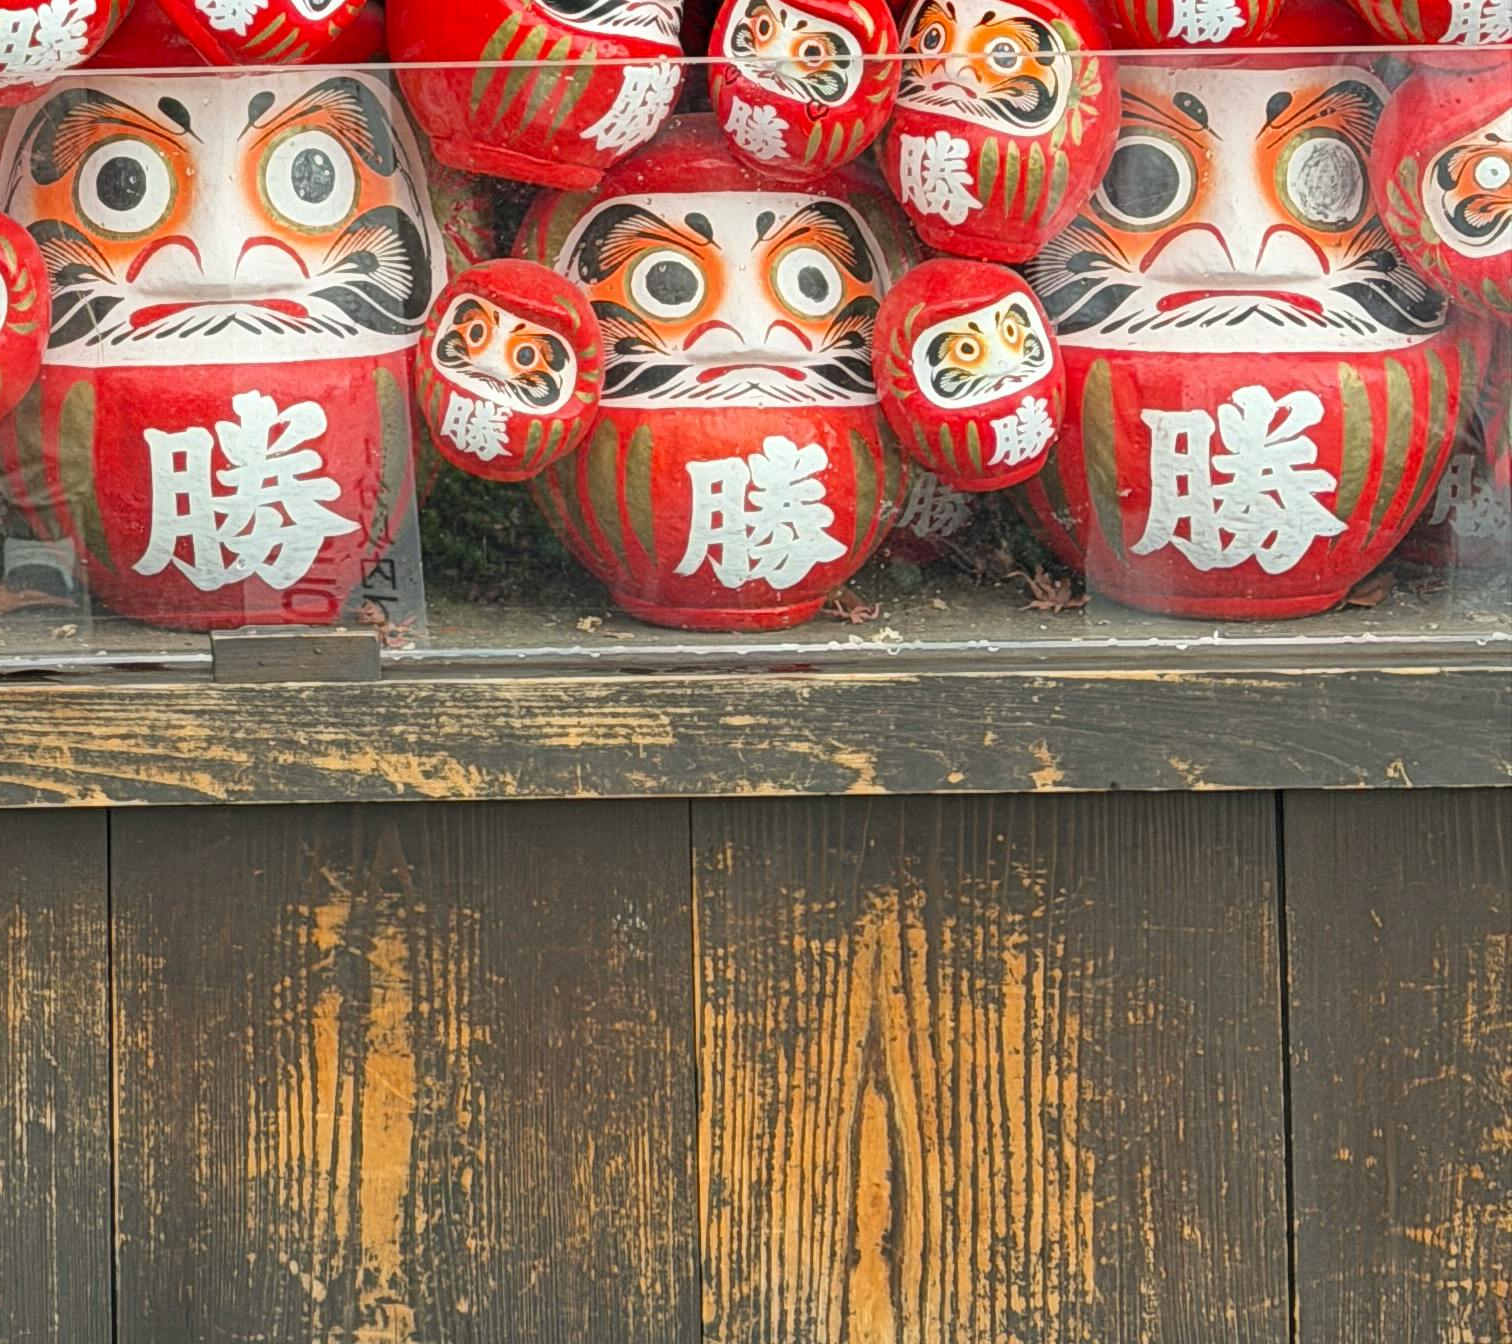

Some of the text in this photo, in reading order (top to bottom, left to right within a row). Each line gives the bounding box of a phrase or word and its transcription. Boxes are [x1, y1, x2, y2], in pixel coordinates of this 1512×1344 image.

[580, 54, 683, 155] 勝
[724, 95, 791, 161] 勝
[899, 130, 983, 225] 勝
[439, 390, 512, 461] 勝
[988, 395, 1056, 466] 勝
[132, 389, 361, 592] 勝
[674, 434, 848, 590] 勝
[1131, 384, 1348, 575] 勝
